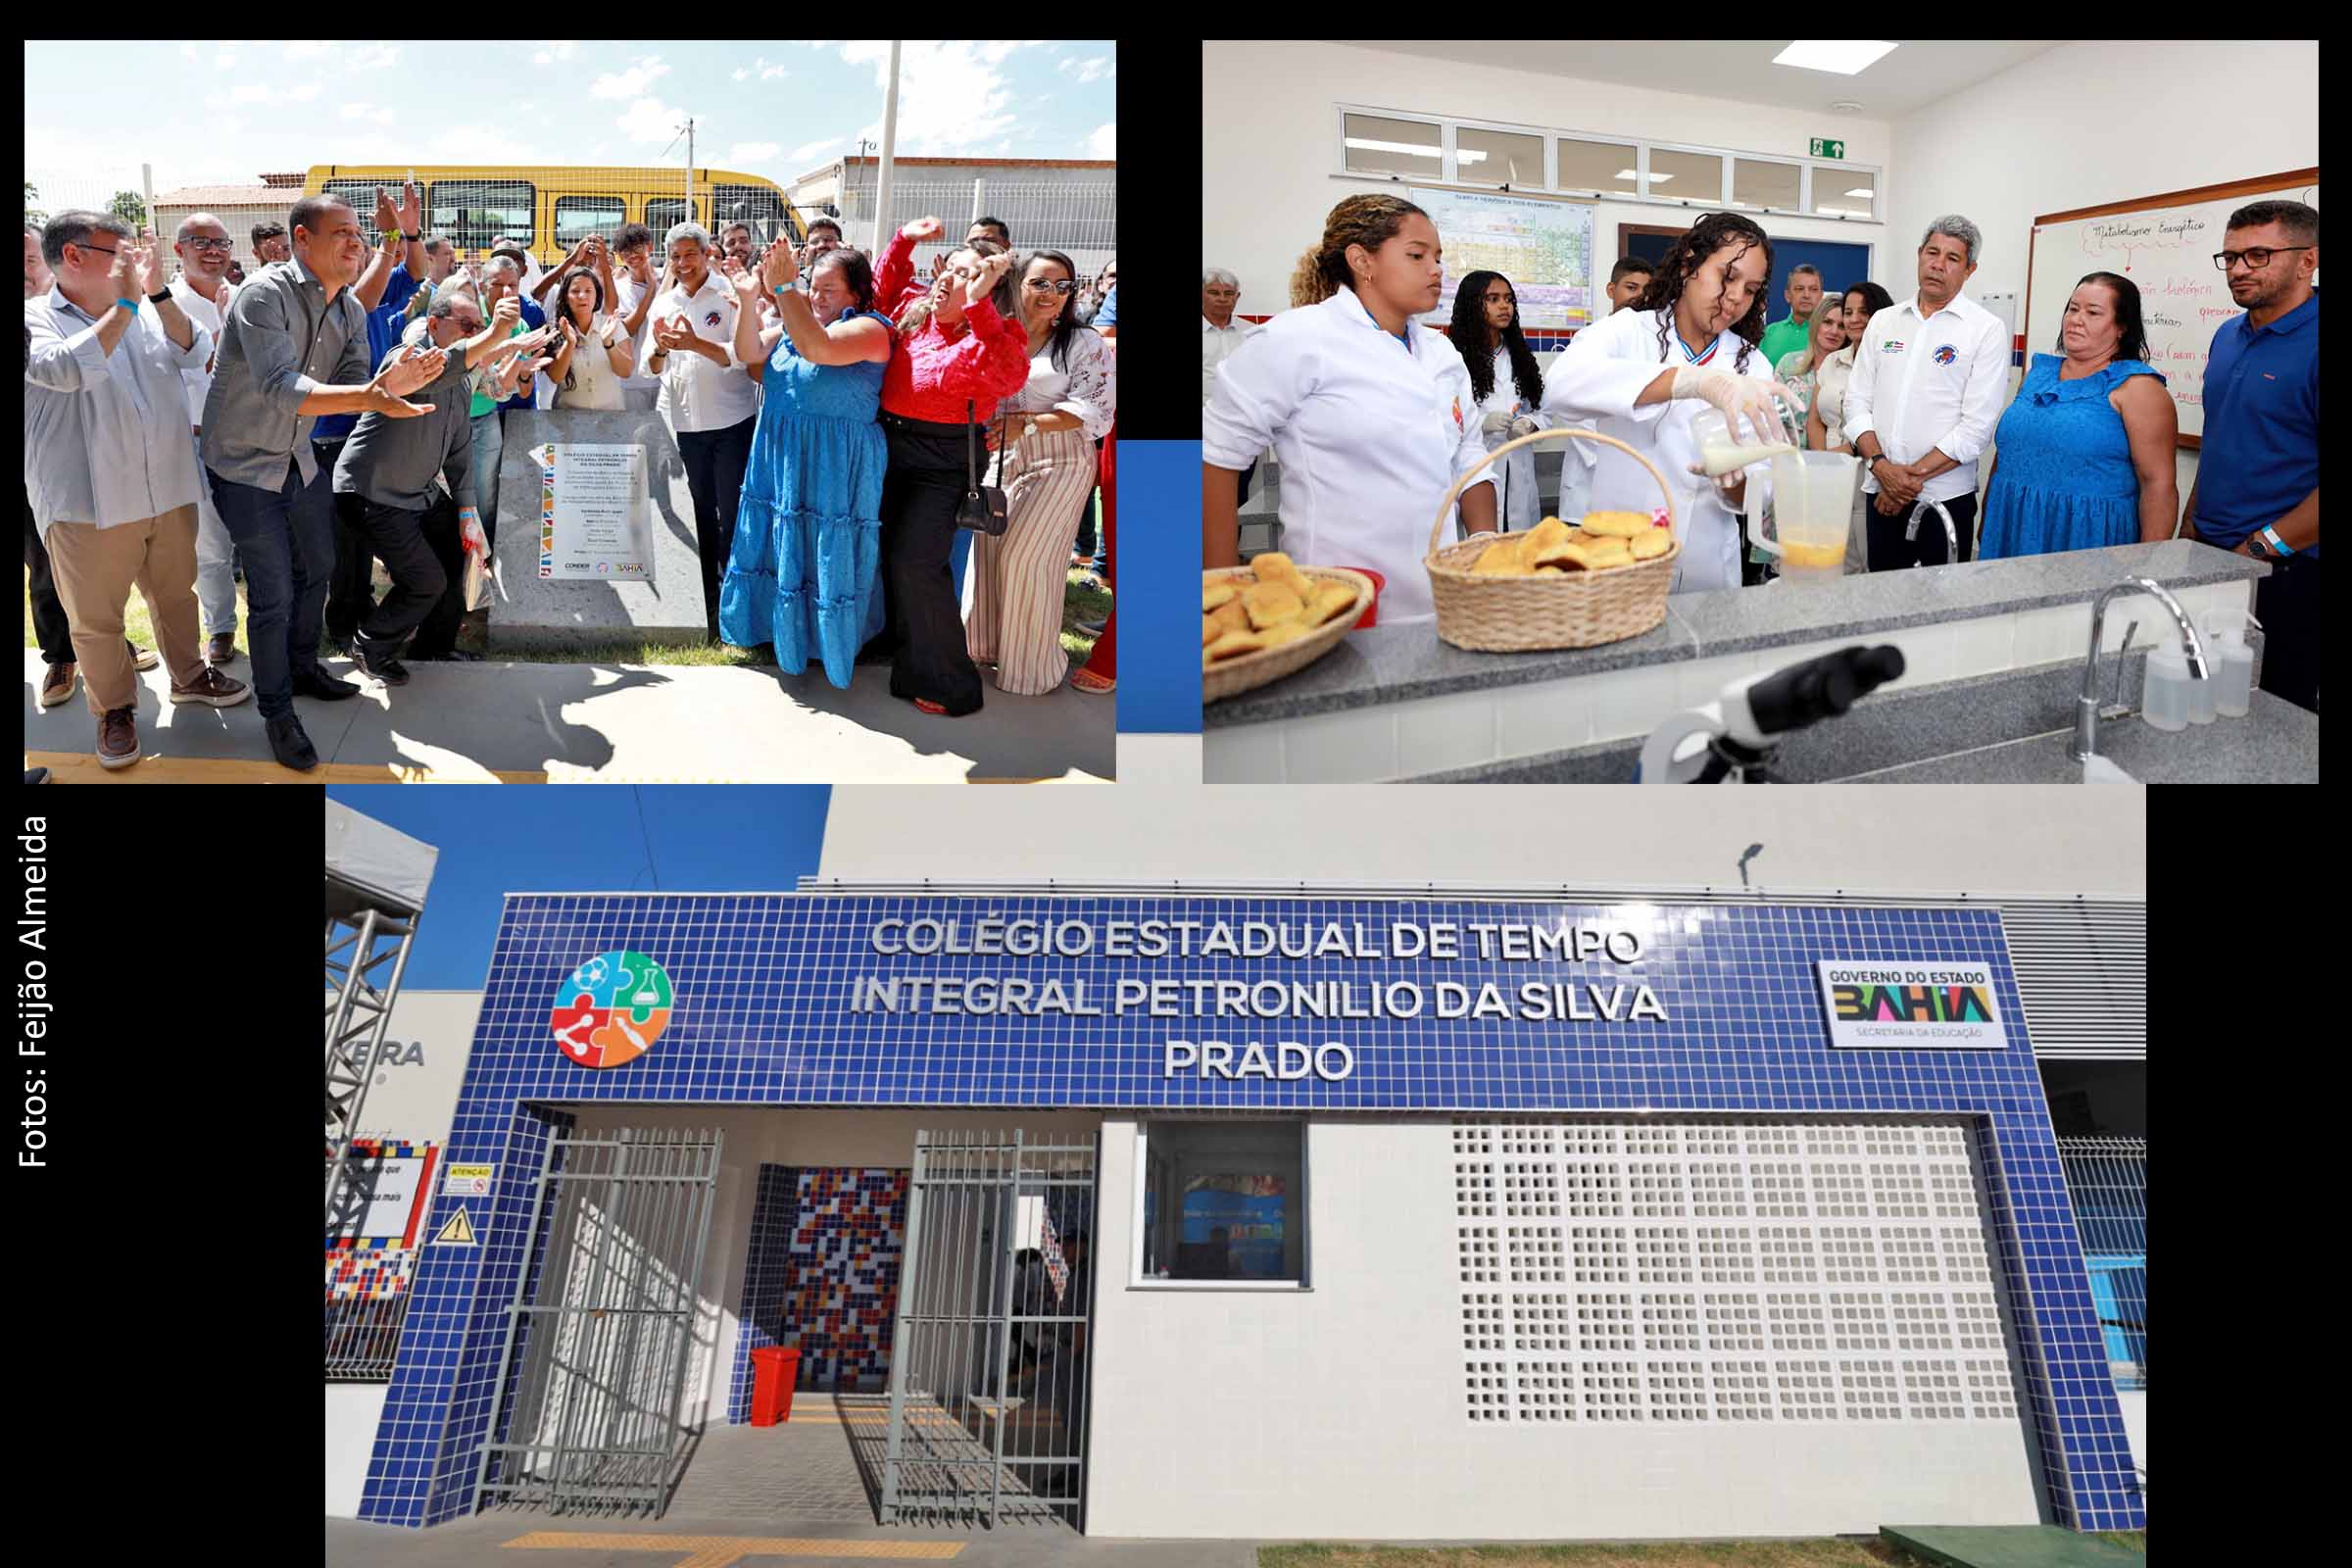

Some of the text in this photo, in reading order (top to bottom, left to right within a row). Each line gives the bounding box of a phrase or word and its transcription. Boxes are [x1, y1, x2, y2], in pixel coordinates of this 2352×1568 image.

[2092, 218, 2205, 239] Metabolismo Energético
[871, 911, 1645, 964] COLÉGIO ESTADUAL DE TEMPO
[1829, 970, 1985, 985] GOVERNO DO ESTADO
[850, 975, 1668, 1022] INTEGRAL PETRONILIO DA SILVA
[1856, 1026, 1983, 1040] SECRETARIA DA EDUCAÇÃO
[1163, 1039, 1353, 1081] PRADO
